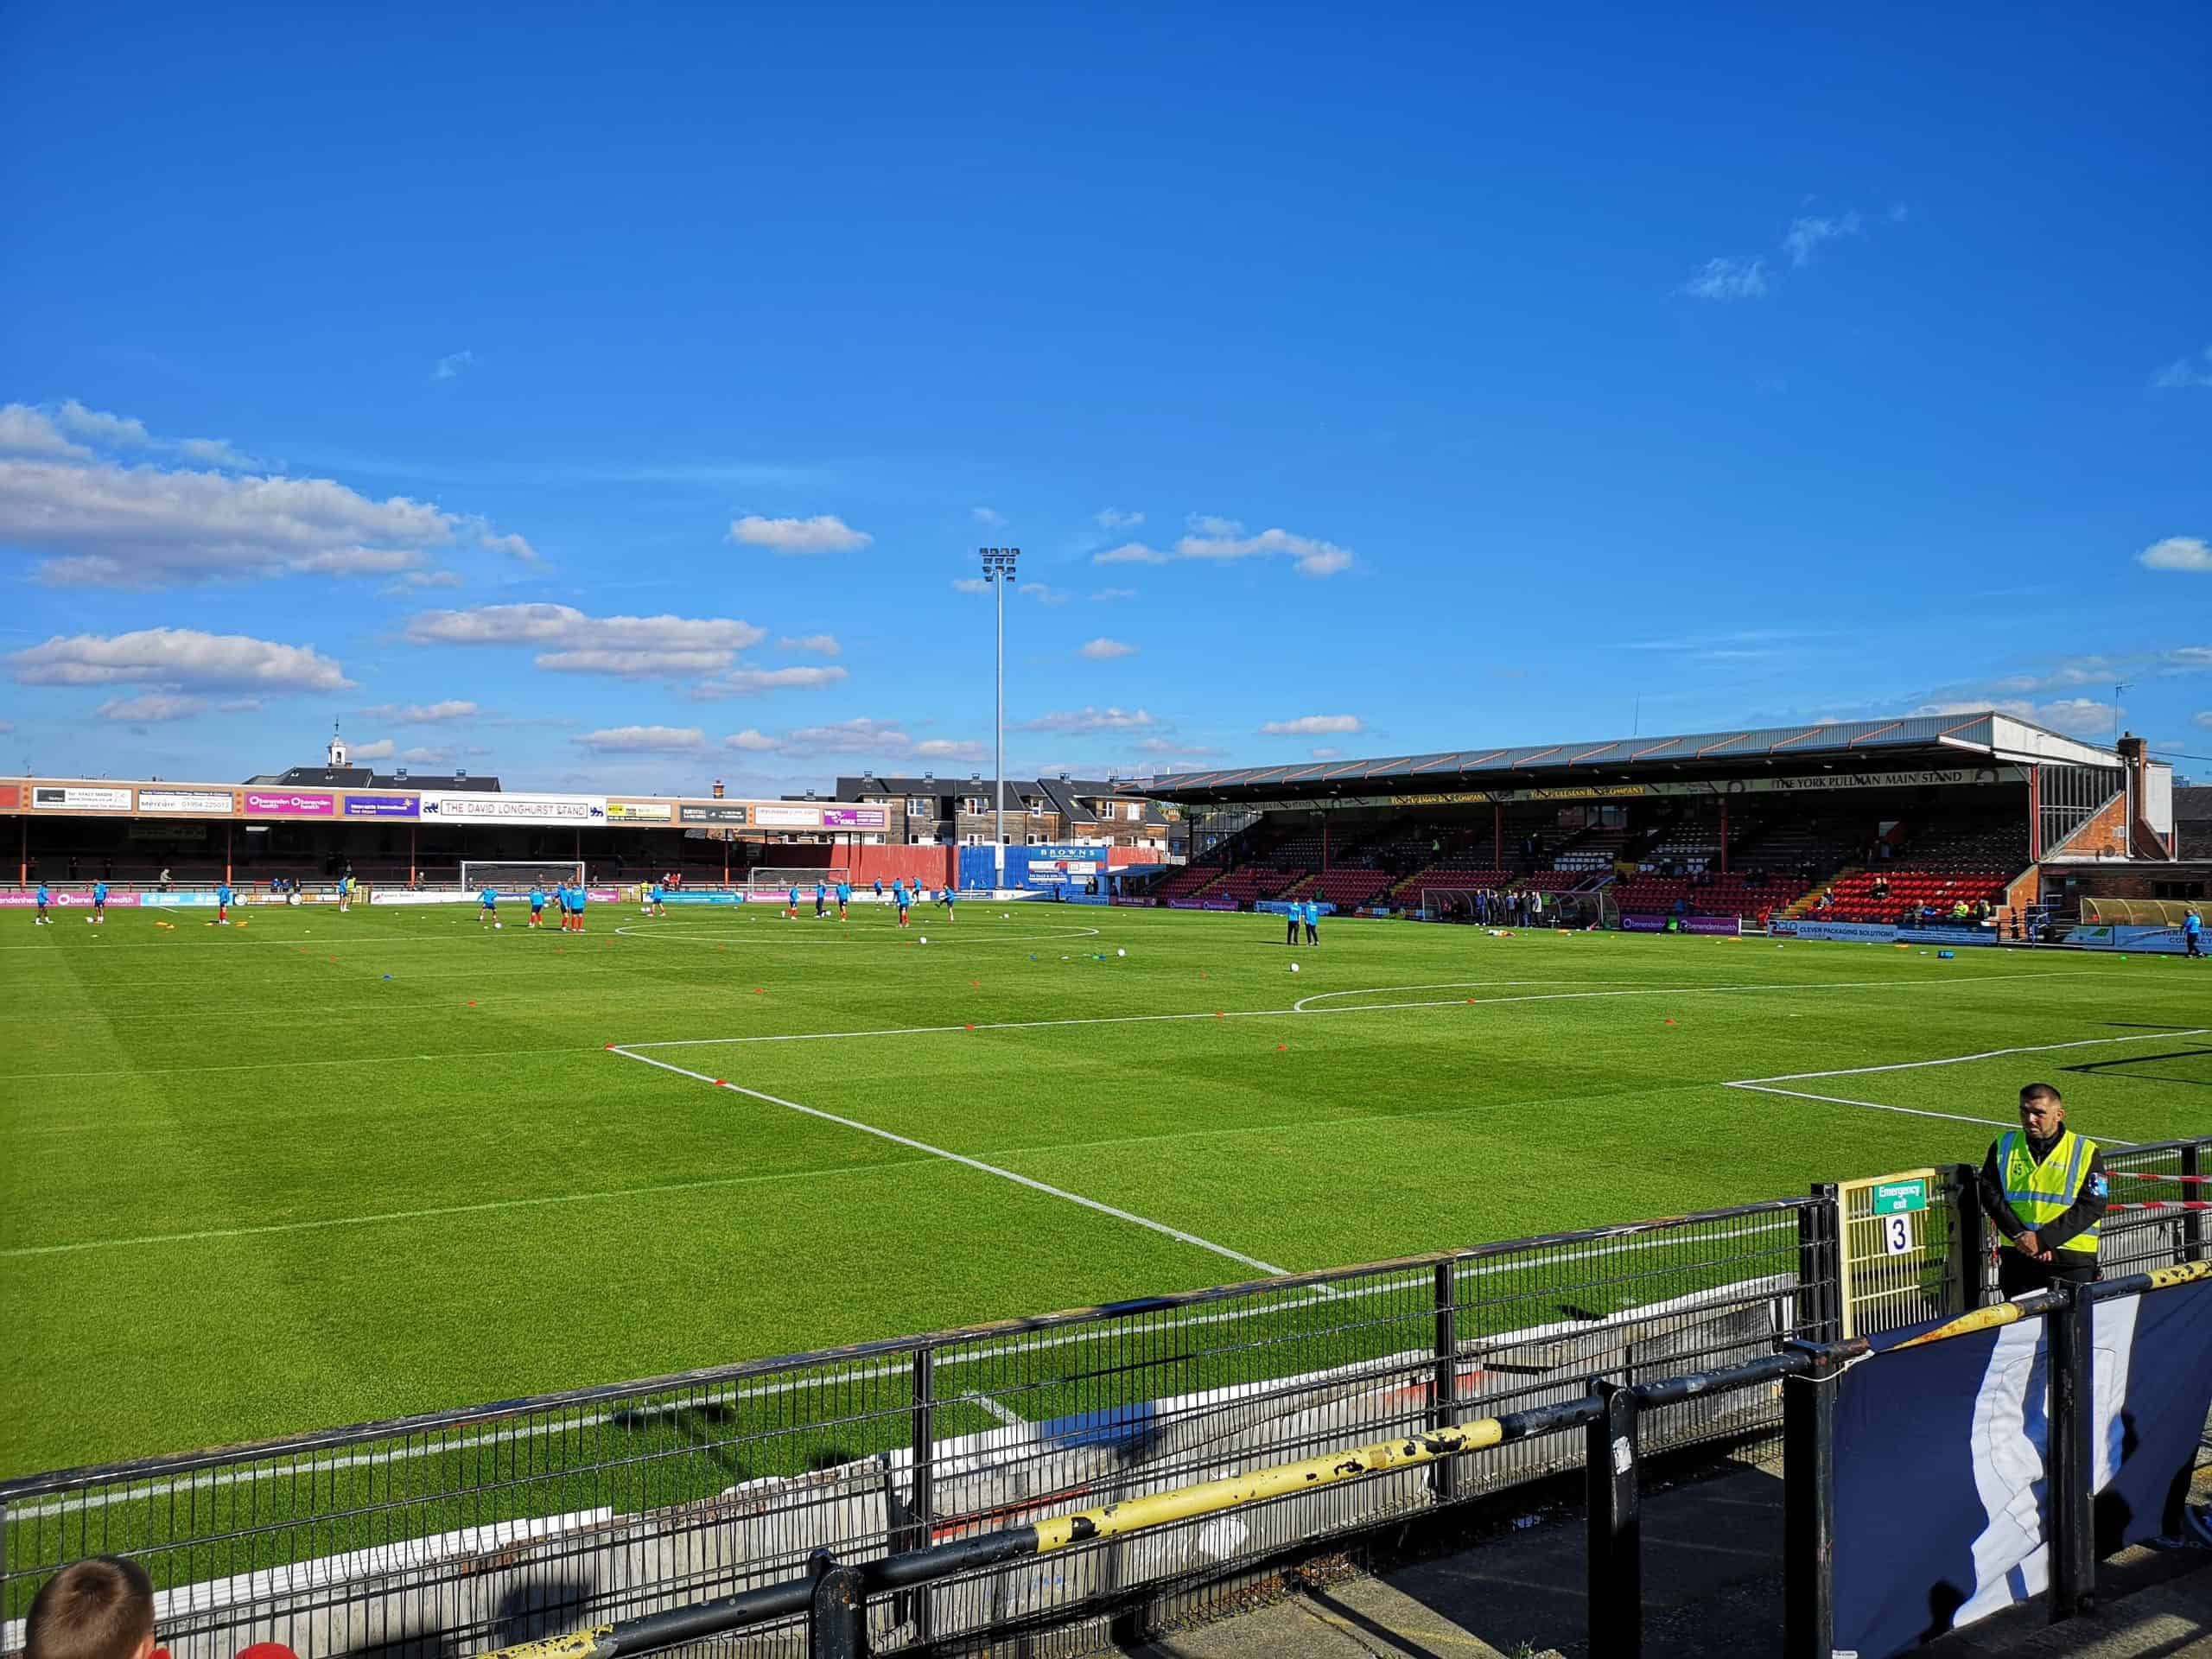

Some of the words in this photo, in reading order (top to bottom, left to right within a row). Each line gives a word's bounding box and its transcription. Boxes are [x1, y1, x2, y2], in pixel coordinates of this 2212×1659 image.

[1776, 779, 1796, 789] THE
[1797, 778, 1826, 788] YORK
[1829, 774, 1880, 787] PULLMAN
[1885, 772, 1916, 785] MAIN
[1922, 771, 1963, 783] STAND
[446, 802, 464, 812] THE
[467, 803, 495, 813] DAVID
[498, 804, 553, 815] LONGHURST
[556, 805, 585, 816] STAND
[1878, 1185, 1921, 1198] Emergency
[1892, 1218, 1906, 1250] 3
